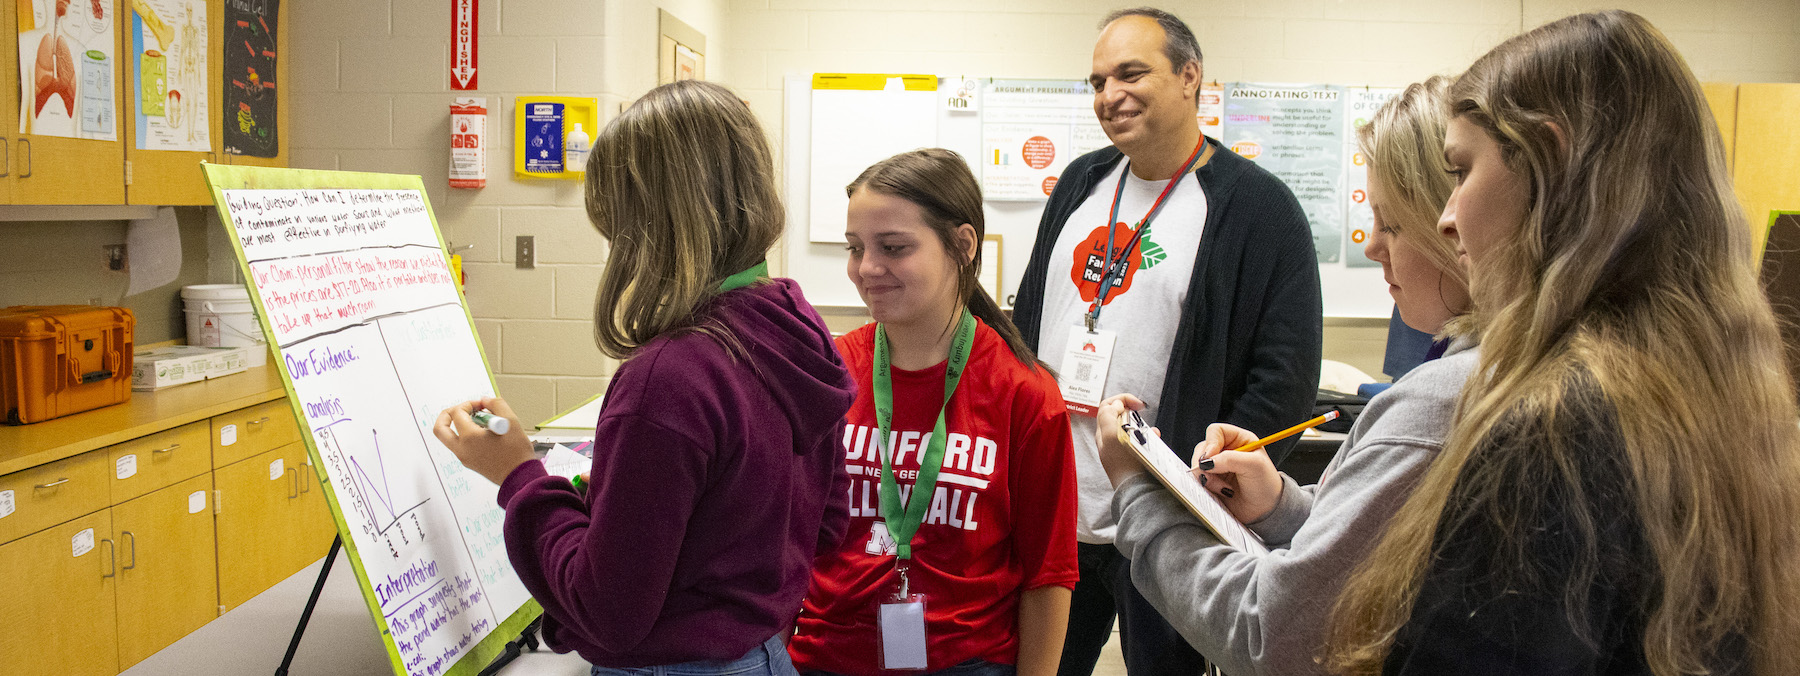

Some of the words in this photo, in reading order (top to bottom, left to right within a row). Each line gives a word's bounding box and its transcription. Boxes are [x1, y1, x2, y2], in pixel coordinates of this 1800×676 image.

[994, 86, 1035, 94] ARGUMENT
[1036, 86, 1089, 95] PRESENTATION
[1231, 89, 1309, 100] ANNOTATING
[1312, 91, 1338, 100] TEXT
[285, 353, 309, 380] Our
[308, 345, 360, 376] Evidence:
[842, 423, 998, 476] UNFRD
[865, 521, 898, 557] M
[375, 558, 440, 609] Interpretation
